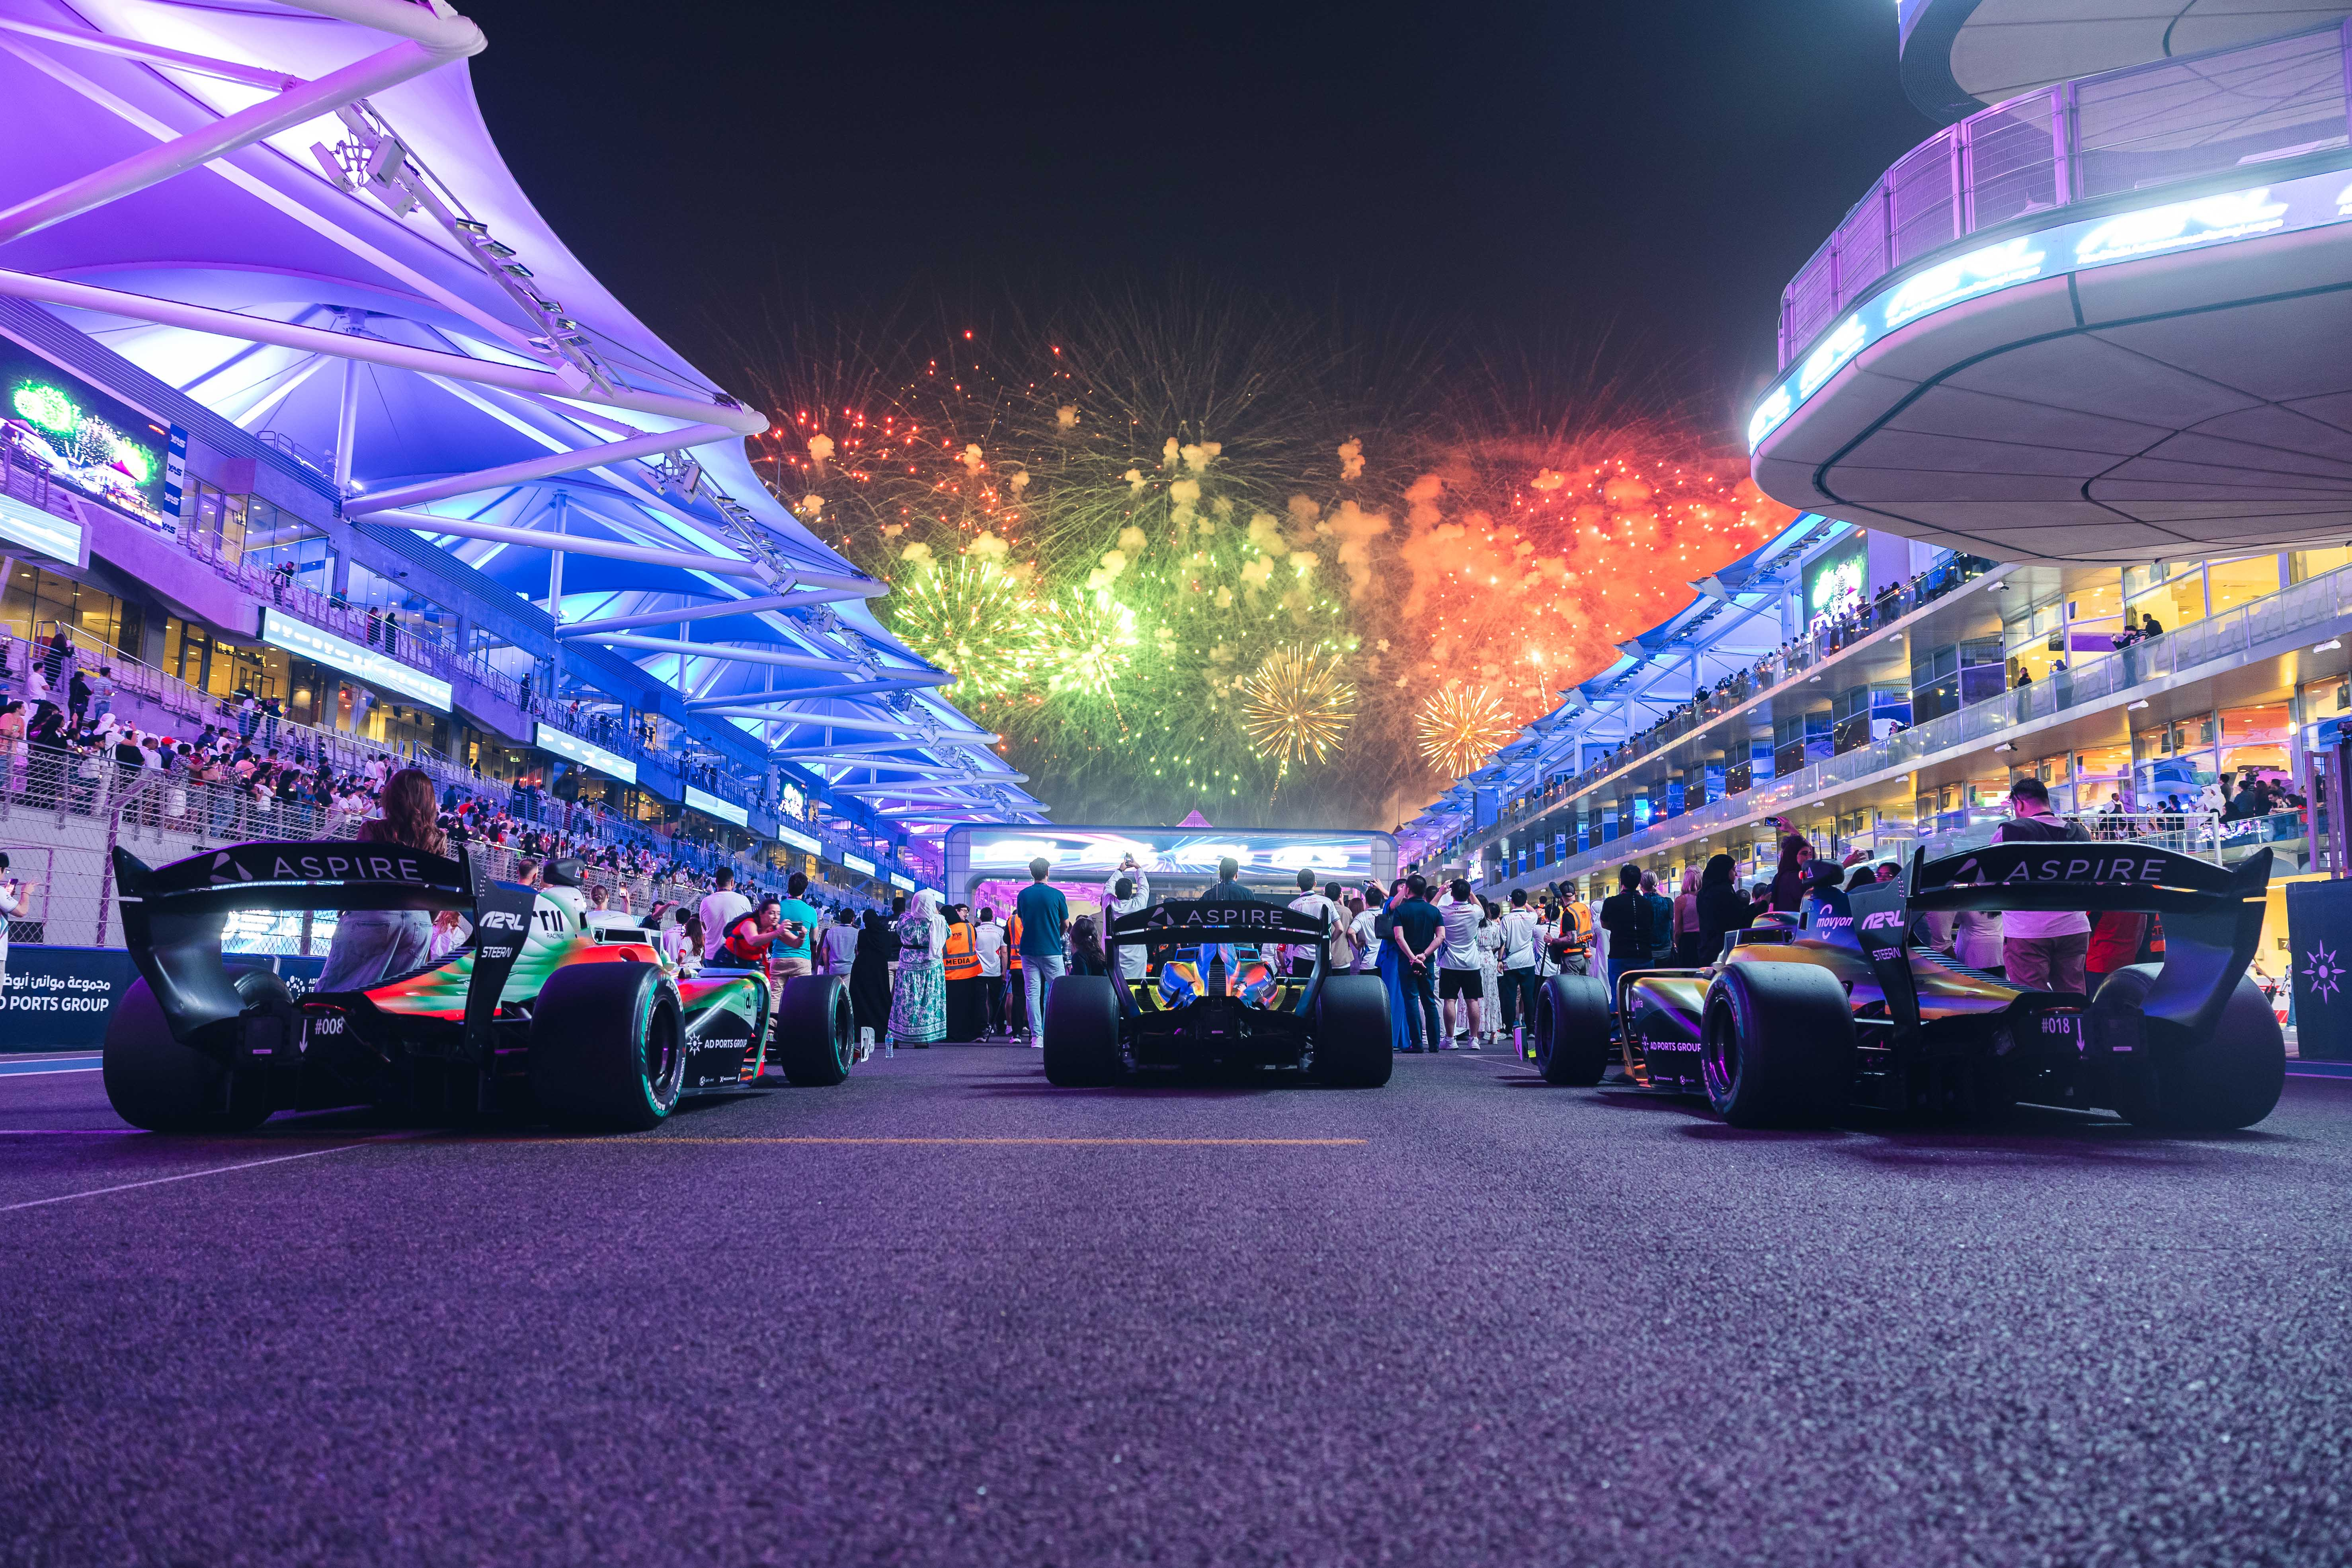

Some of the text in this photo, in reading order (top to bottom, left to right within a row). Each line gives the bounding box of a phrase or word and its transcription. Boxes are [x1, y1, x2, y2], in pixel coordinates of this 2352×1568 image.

[171, 433, 186, 448] YAS
[168, 463, 182, 476] YAS
[164, 492, 180, 506] YAS
[161, 521, 176, 534] YAS
[273, 856, 423, 881] ASPIRE
[2003, 858, 2167, 881] ASPIRE
[1187, 909, 1283, 924] ASPIRE
[1816, 917, 1854, 929] movyon
[945, 957, 970, 966] MEDIA
[67, 976, 111, 992] مجموعة
[10, 996, 59, 1011] PORTS
[61, 997, 109, 1011] GROUP
[315, 1018, 344, 1035] #008
[2041, 1017, 2070, 1034] #018
[705, 1039, 747, 1049] AD PORTS GROUP
[1650, 1041, 1657, 1051] AD
[1657, 1041, 1676, 1051] PORTS
